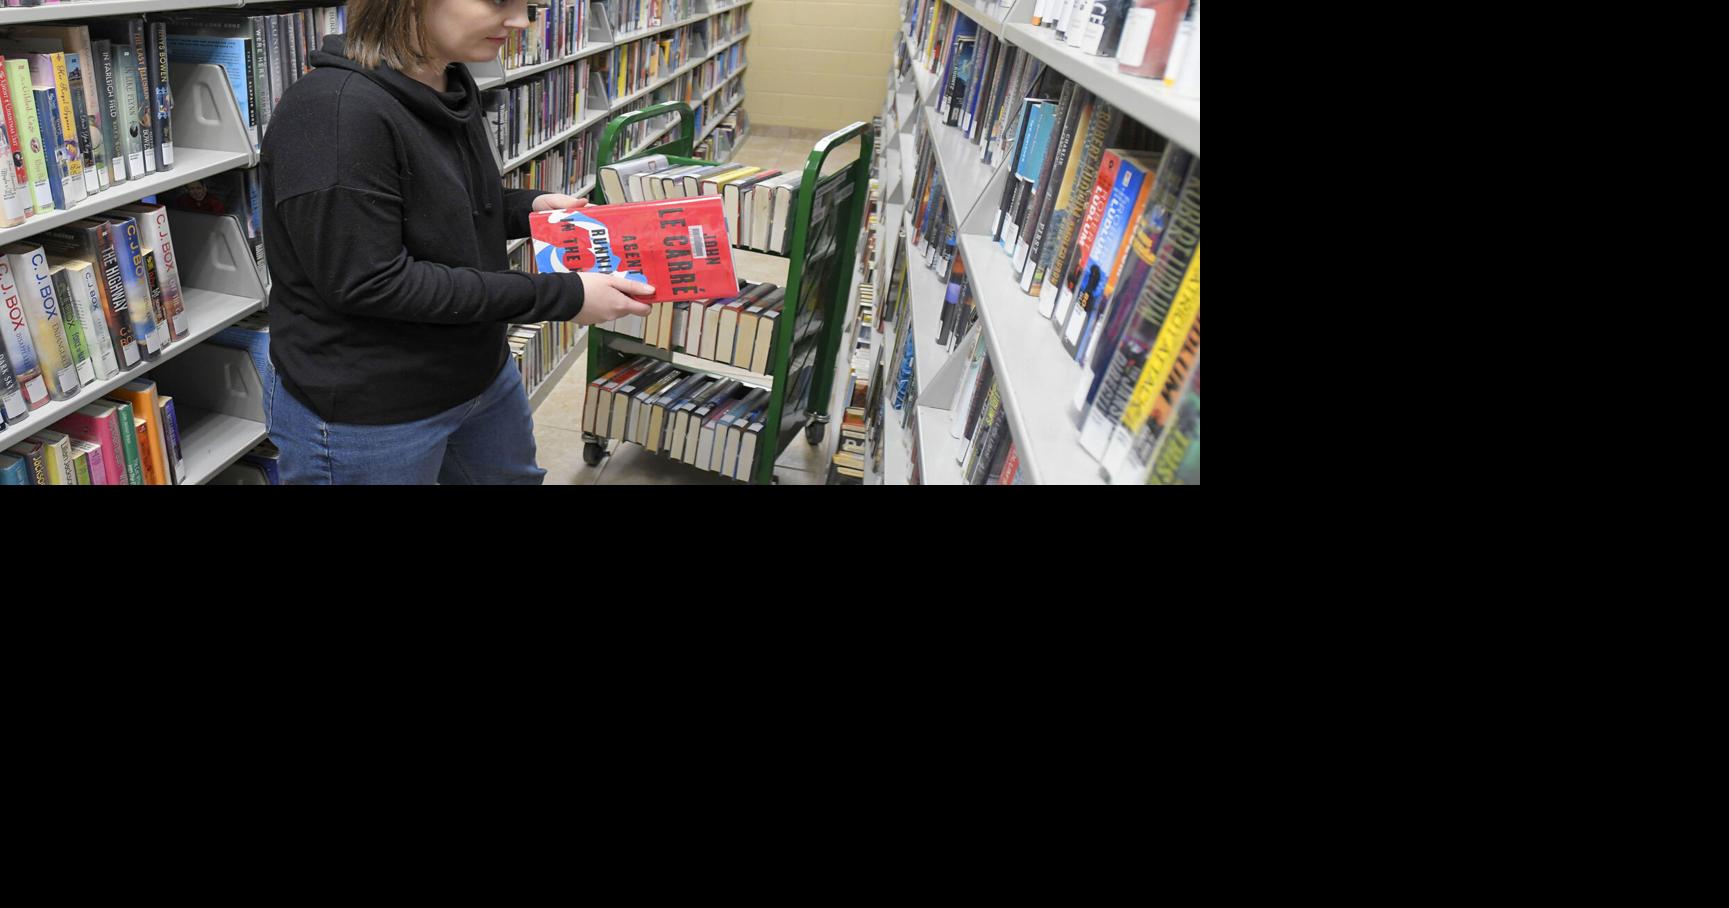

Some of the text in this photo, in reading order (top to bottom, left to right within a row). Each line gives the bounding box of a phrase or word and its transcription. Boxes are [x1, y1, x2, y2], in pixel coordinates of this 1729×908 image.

[136, 48, 145, 65] LAST
[255, 29, 263, 53] WERE
[55, 65, 65, 81] Her
[102, 52, 117, 118] IN FARLEIGH FIELD
[158, 52, 168, 83] BOWEN
[257, 57, 265, 79] HERE
[58, 83, 68, 105] Royal
[1058, 133, 1072, 166] CHARLIE
[1088, 110, 1111, 161] ROBERT
[127, 225, 136, 240] C.
[560, 218, 576, 232] IN
[1078, 185, 1102, 247] LUDLUM
[1093, 198, 1119, 261] LUDLUM
[130, 242, 139, 254] J.
[156, 214, 175, 272] C. J. BOX
[563, 238, 581, 262] THE
[591, 229, 613, 275] RUNNI
[622, 235, 644, 276] AGENT
[657, 207, 706, 296] LE CARRÉ
[1032, 223, 1046, 254] FIRST
[1, 283, 14, 295] J.
[31, 253, 58, 321] C. J. BOX
[85, 272, 92, 281] C.
[90, 290, 99, 311] BOX
[101, 245, 128, 313] THE HIGHWAY
[5, 296, 25, 331] BOX
[0, 354, 14, 391] DARK SKY
[1098, 352, 1128, 414] DIRECTI
[1108, 375, 1135, 421] JANS
